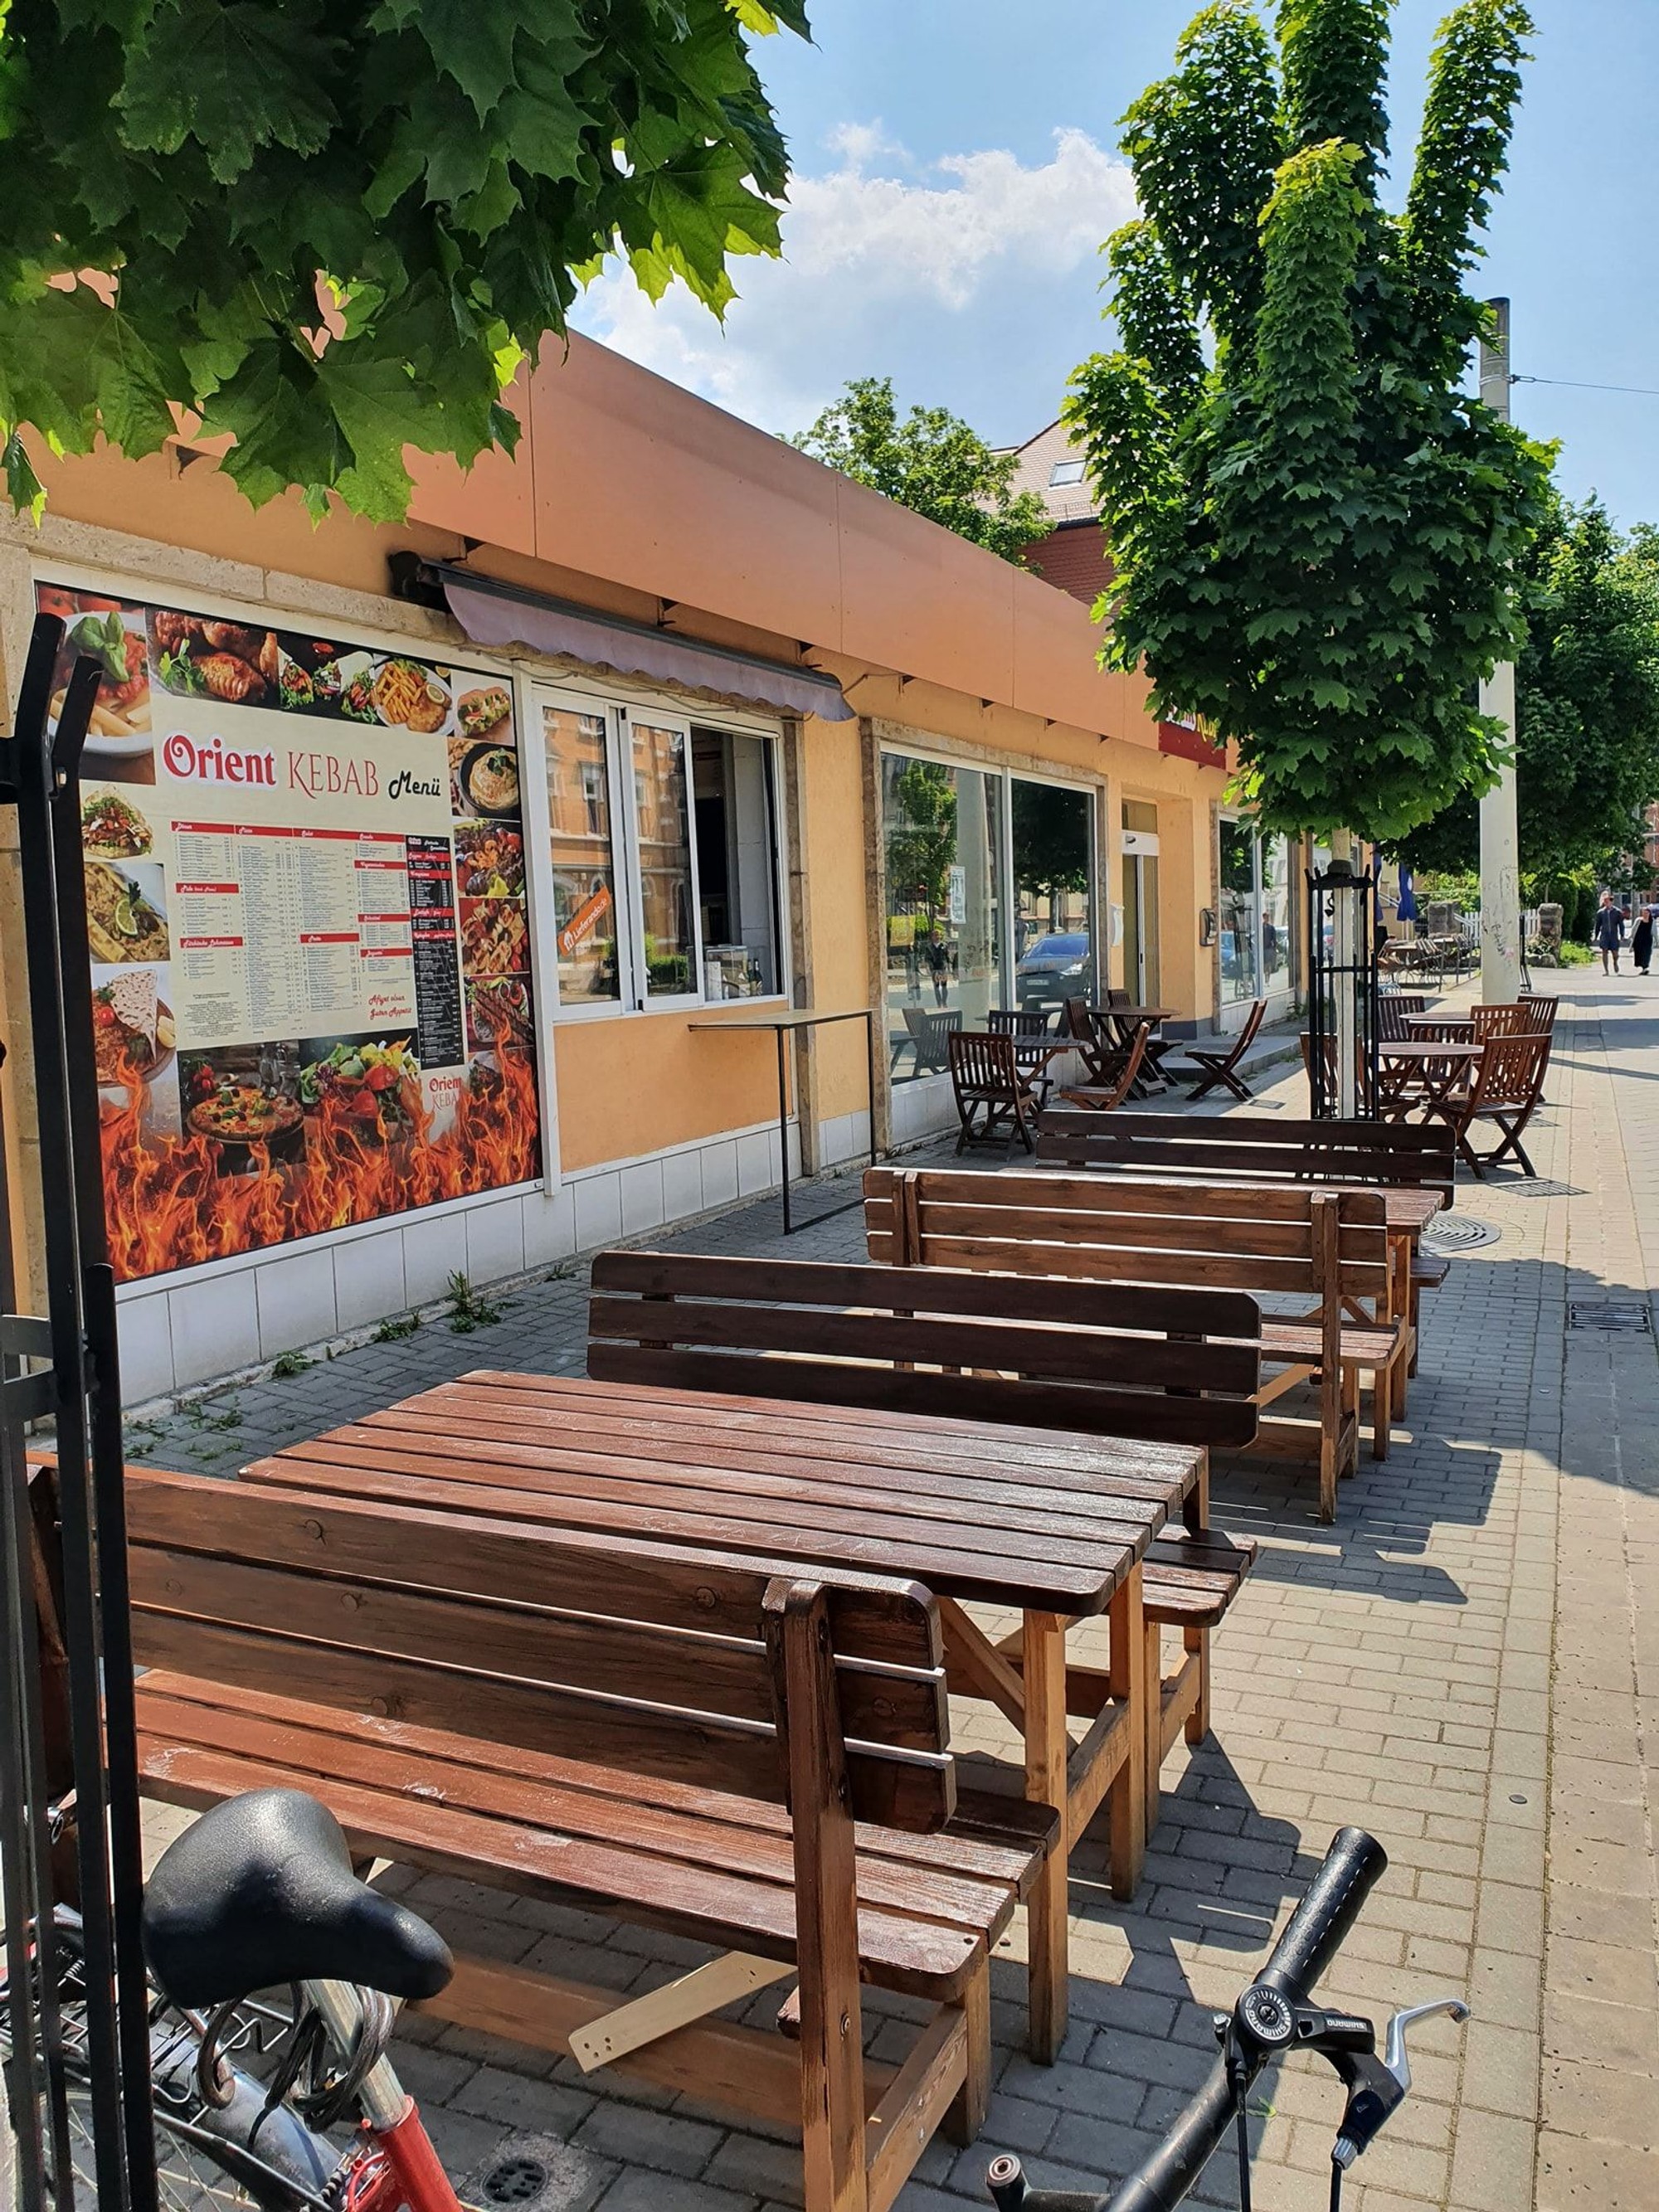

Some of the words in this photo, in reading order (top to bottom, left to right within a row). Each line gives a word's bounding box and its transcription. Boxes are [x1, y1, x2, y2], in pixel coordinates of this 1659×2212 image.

[163, 735, 276, 785] Orient
[288, 751, 379, 800] KEBAB
[388, 771, 441, 799] Menü
[1248, 2009, 1287, 2038] SHIMANO
[1326, 2018, 1366, 2030] SHIMANO
